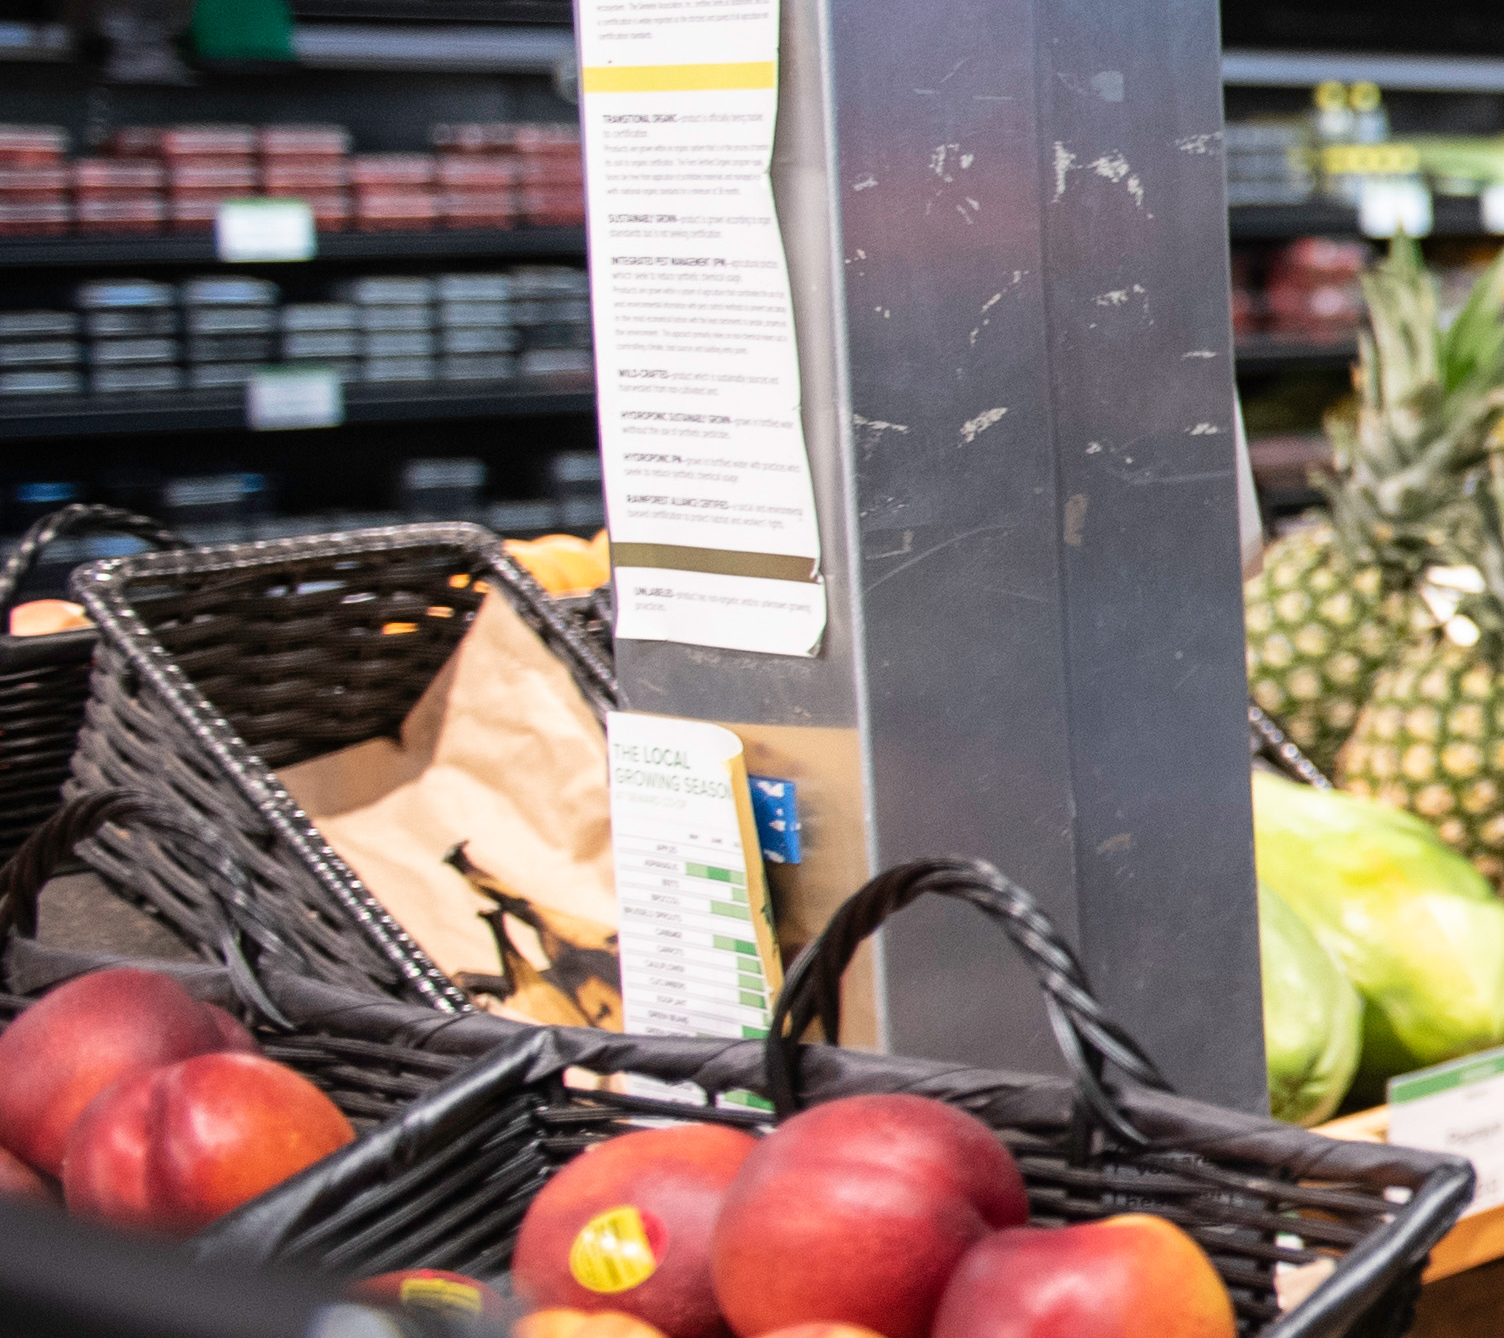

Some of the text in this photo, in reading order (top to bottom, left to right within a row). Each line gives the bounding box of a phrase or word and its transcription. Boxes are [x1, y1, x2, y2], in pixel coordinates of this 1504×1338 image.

[613, 743, 691, 770] THE LOCAL
[615, 767, 681, 792] GROWING
